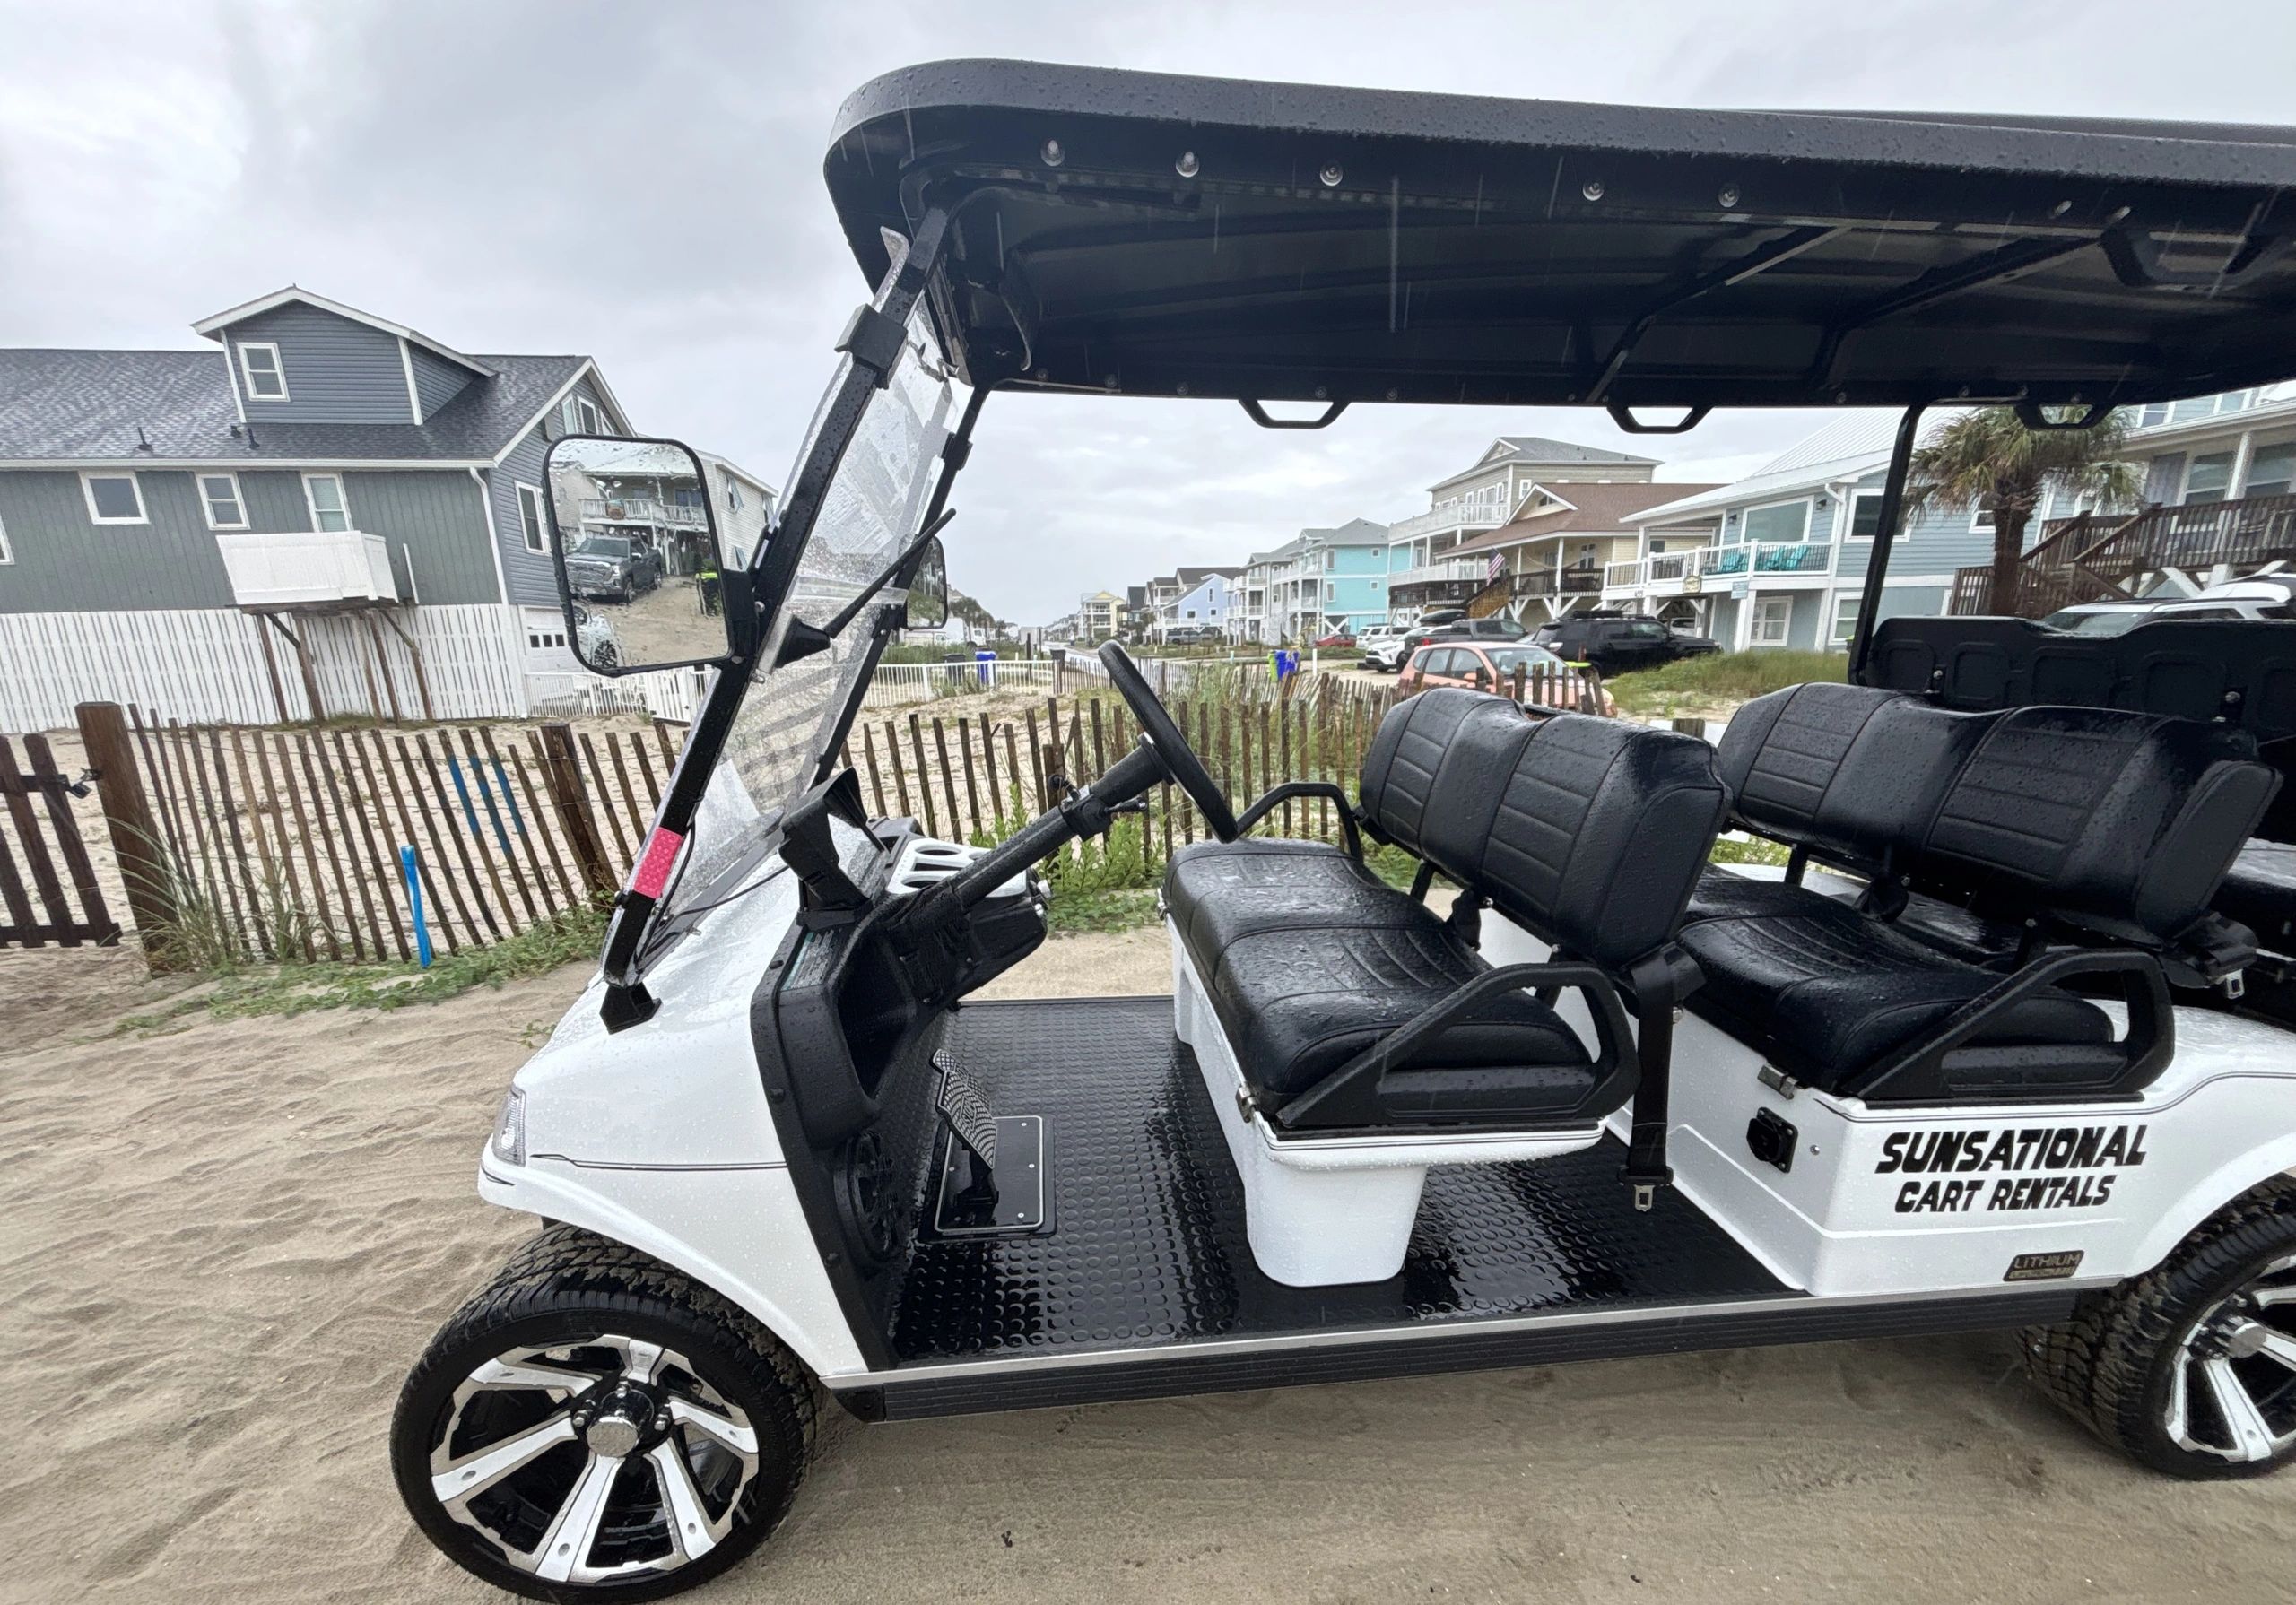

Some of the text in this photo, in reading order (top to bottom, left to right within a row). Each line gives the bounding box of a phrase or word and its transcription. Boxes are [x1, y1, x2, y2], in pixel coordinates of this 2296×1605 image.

[1874, 1124, 2147, 1174] SUNSATIONAL
[1894, 1175, 2117, 1213] CART RENTALS
[2013, 1254, 2082, 1269] LITHIUM
